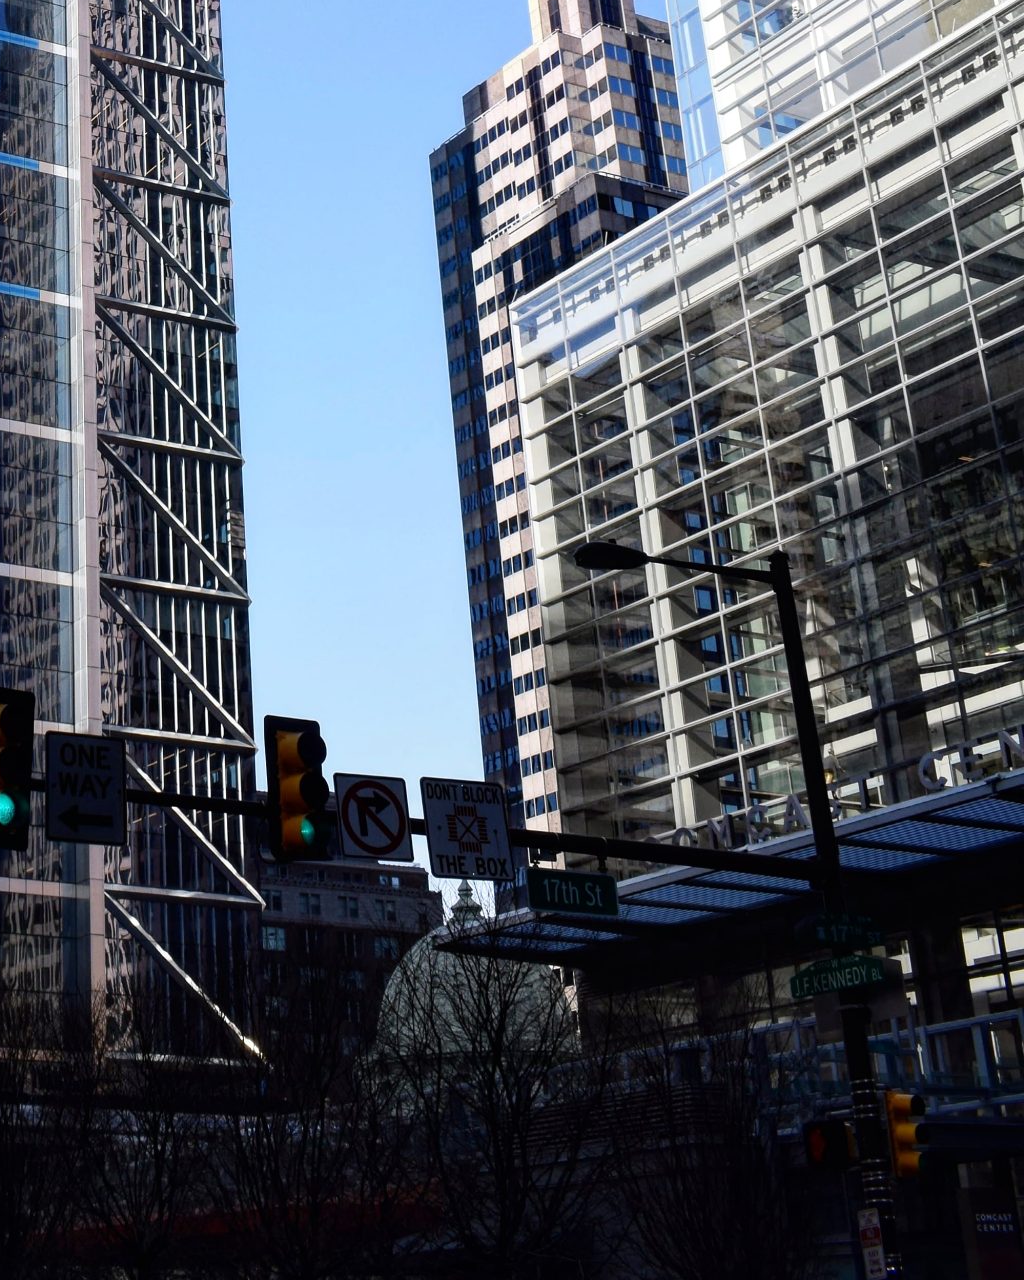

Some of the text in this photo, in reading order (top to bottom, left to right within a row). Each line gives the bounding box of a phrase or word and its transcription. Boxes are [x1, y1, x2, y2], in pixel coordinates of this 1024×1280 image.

[61, 742, 111, 770] ONE
[59, 772, 112, 800] WAY
[462, 786, 500, 804] BLOCK
[642, 772, 870, 871] OMCAST
[436, 854, 509, 877] THE BOX
[543, 878, 604, 907] 17th St
